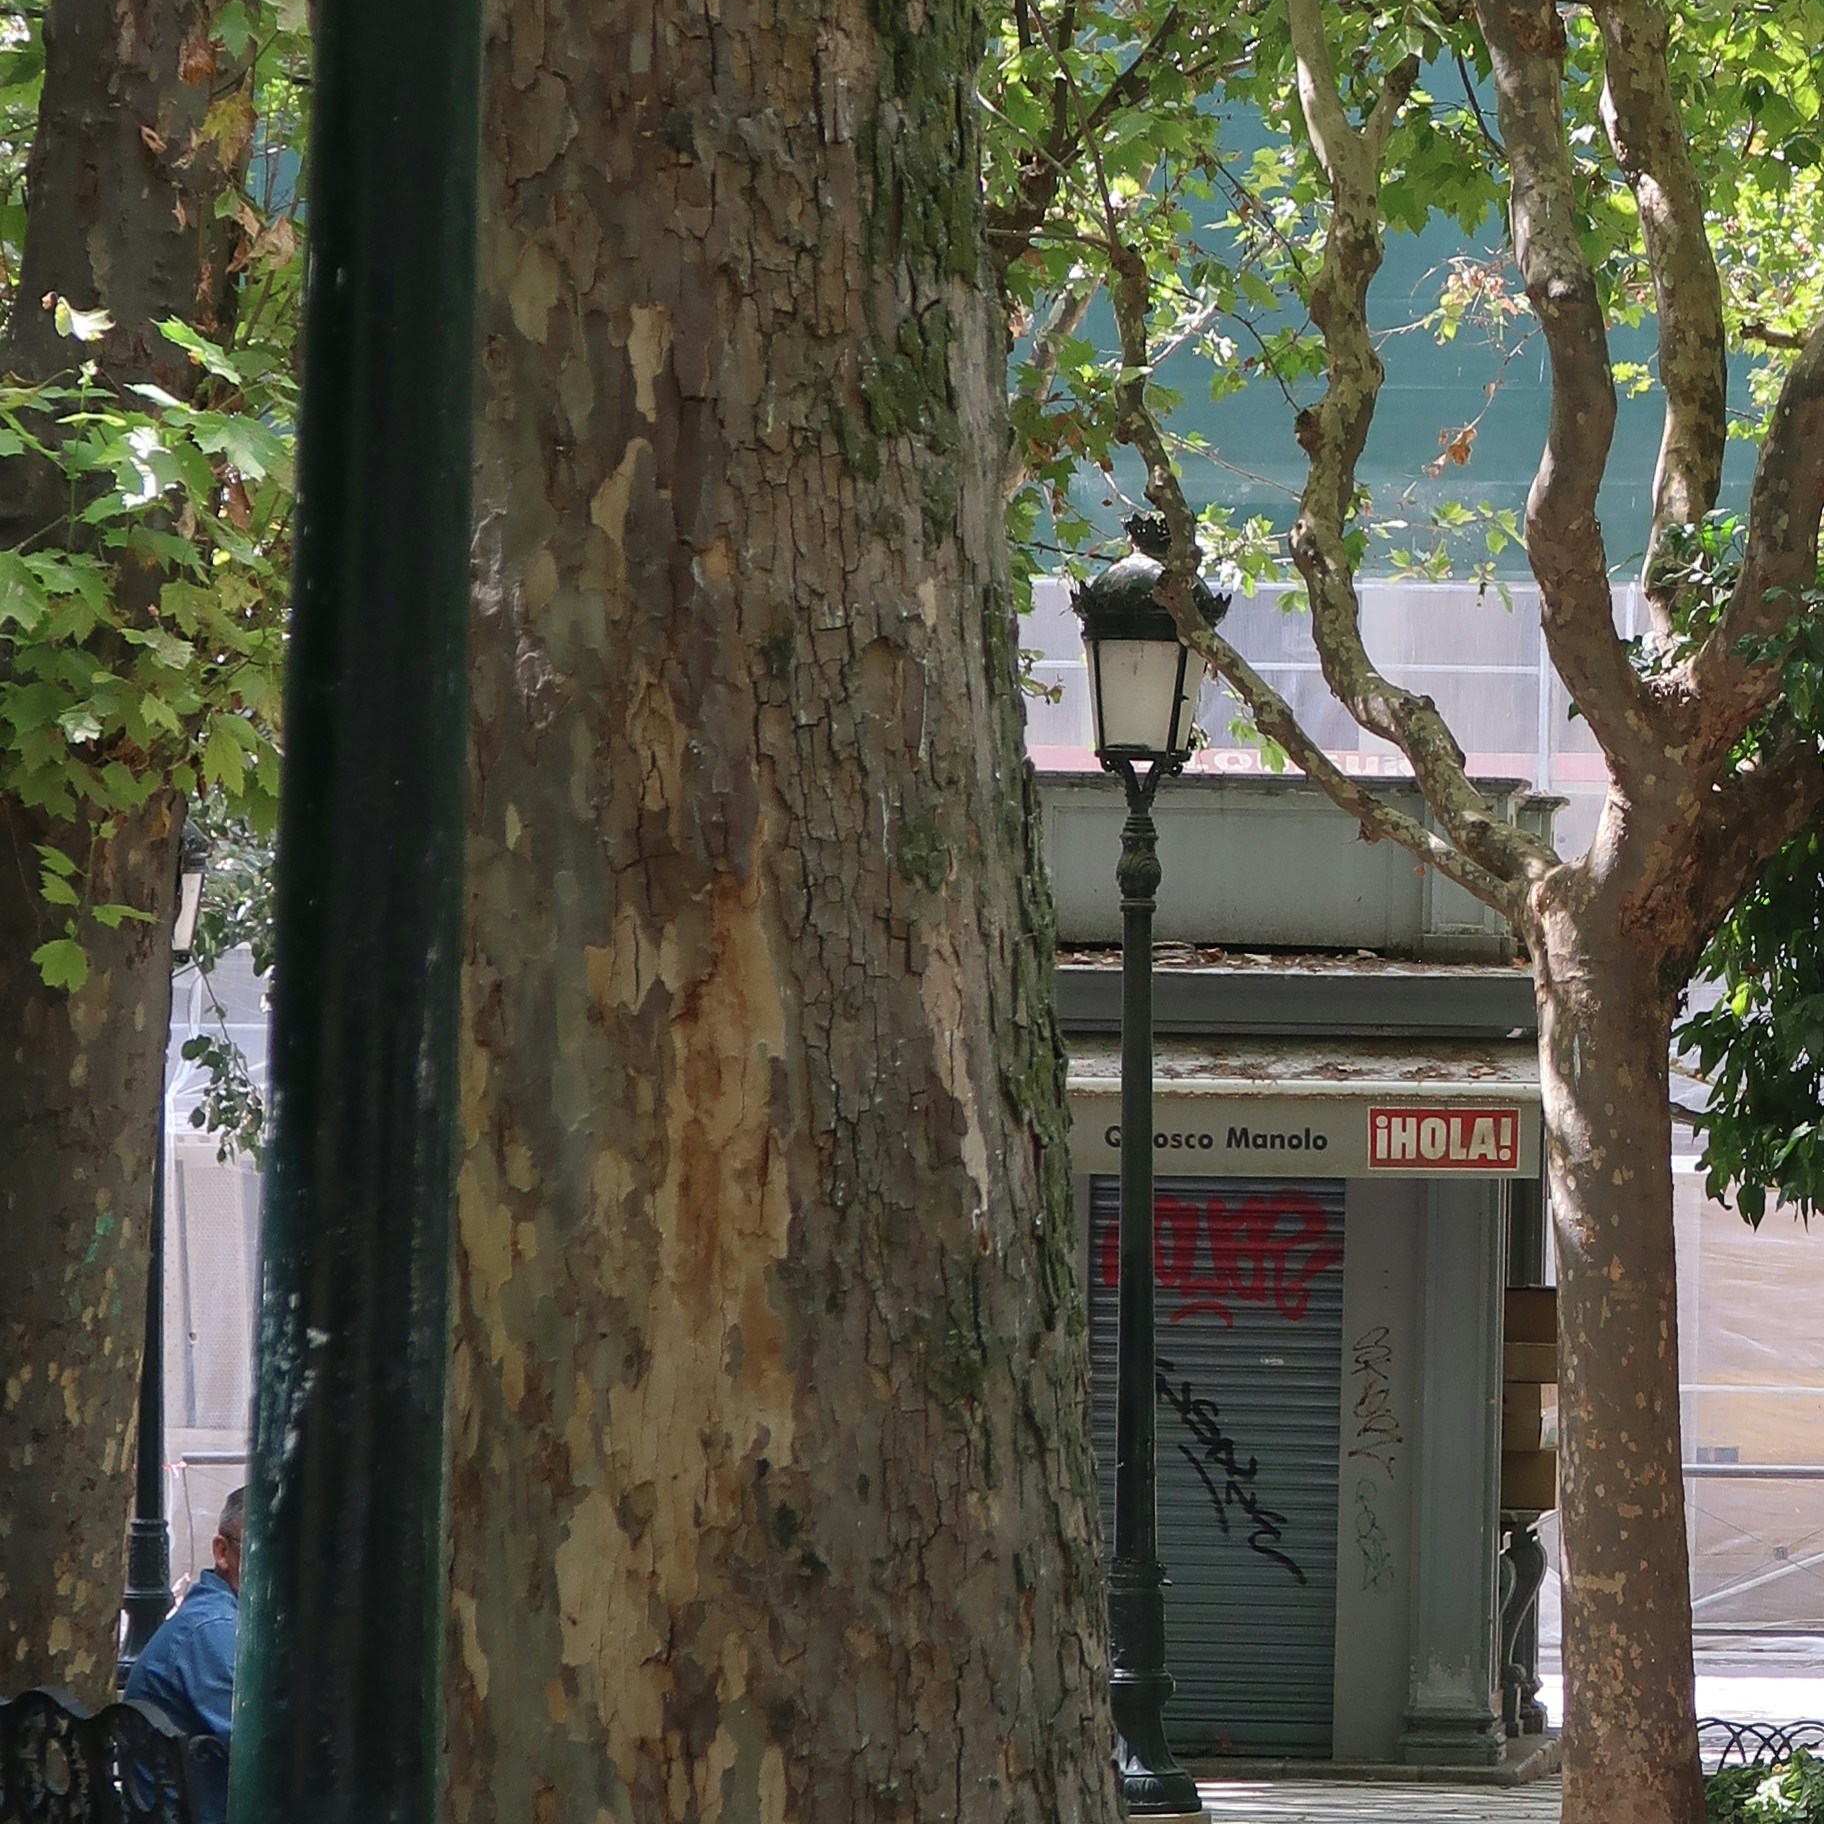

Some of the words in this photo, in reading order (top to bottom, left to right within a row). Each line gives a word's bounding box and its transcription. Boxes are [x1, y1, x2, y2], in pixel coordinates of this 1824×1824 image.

[1104, 1125, 1214, 1149] Qosco
[1226, 1126, 1328, 1150] Manolo
[1375, 1115, 1512, 1161] ¡HOLA!
